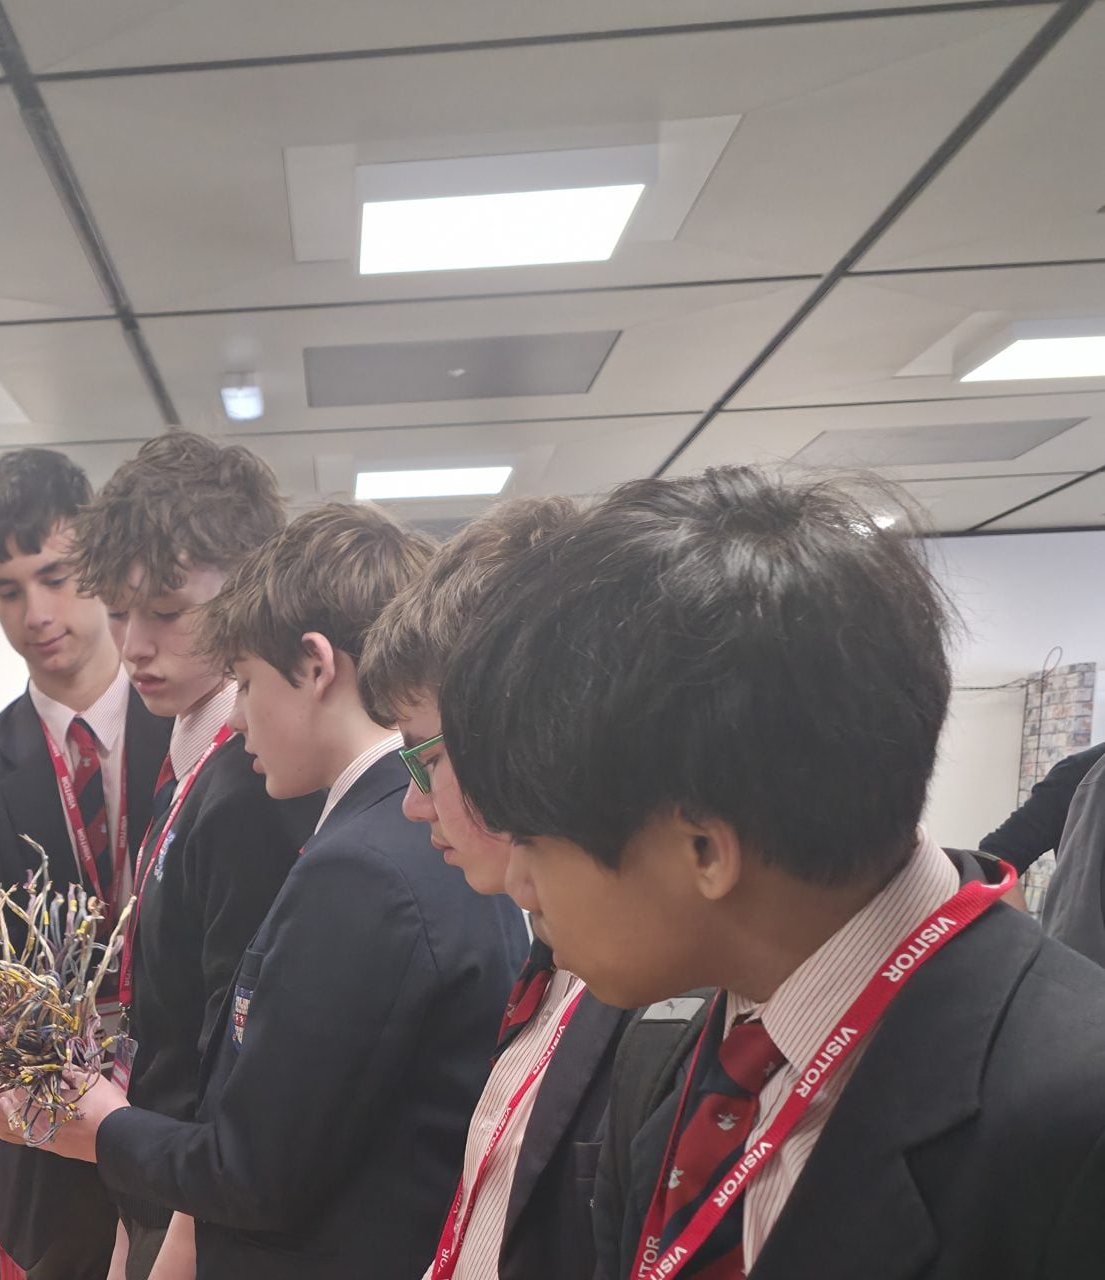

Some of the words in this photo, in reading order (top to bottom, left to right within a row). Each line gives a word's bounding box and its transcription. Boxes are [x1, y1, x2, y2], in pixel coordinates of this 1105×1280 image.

[61, 776, 77, 810] VISITOR
[76, 828, 92, 861] VISITOR
[881, 916, 957, 982] VISITOR
[532, 1025, 565, 1075] VISITOR
[796, 1026, 858, 1098] VISITOR
[485, 1107, 512, 1156] VISITOR
[713, 1141, 773, 1207] VISITOR
